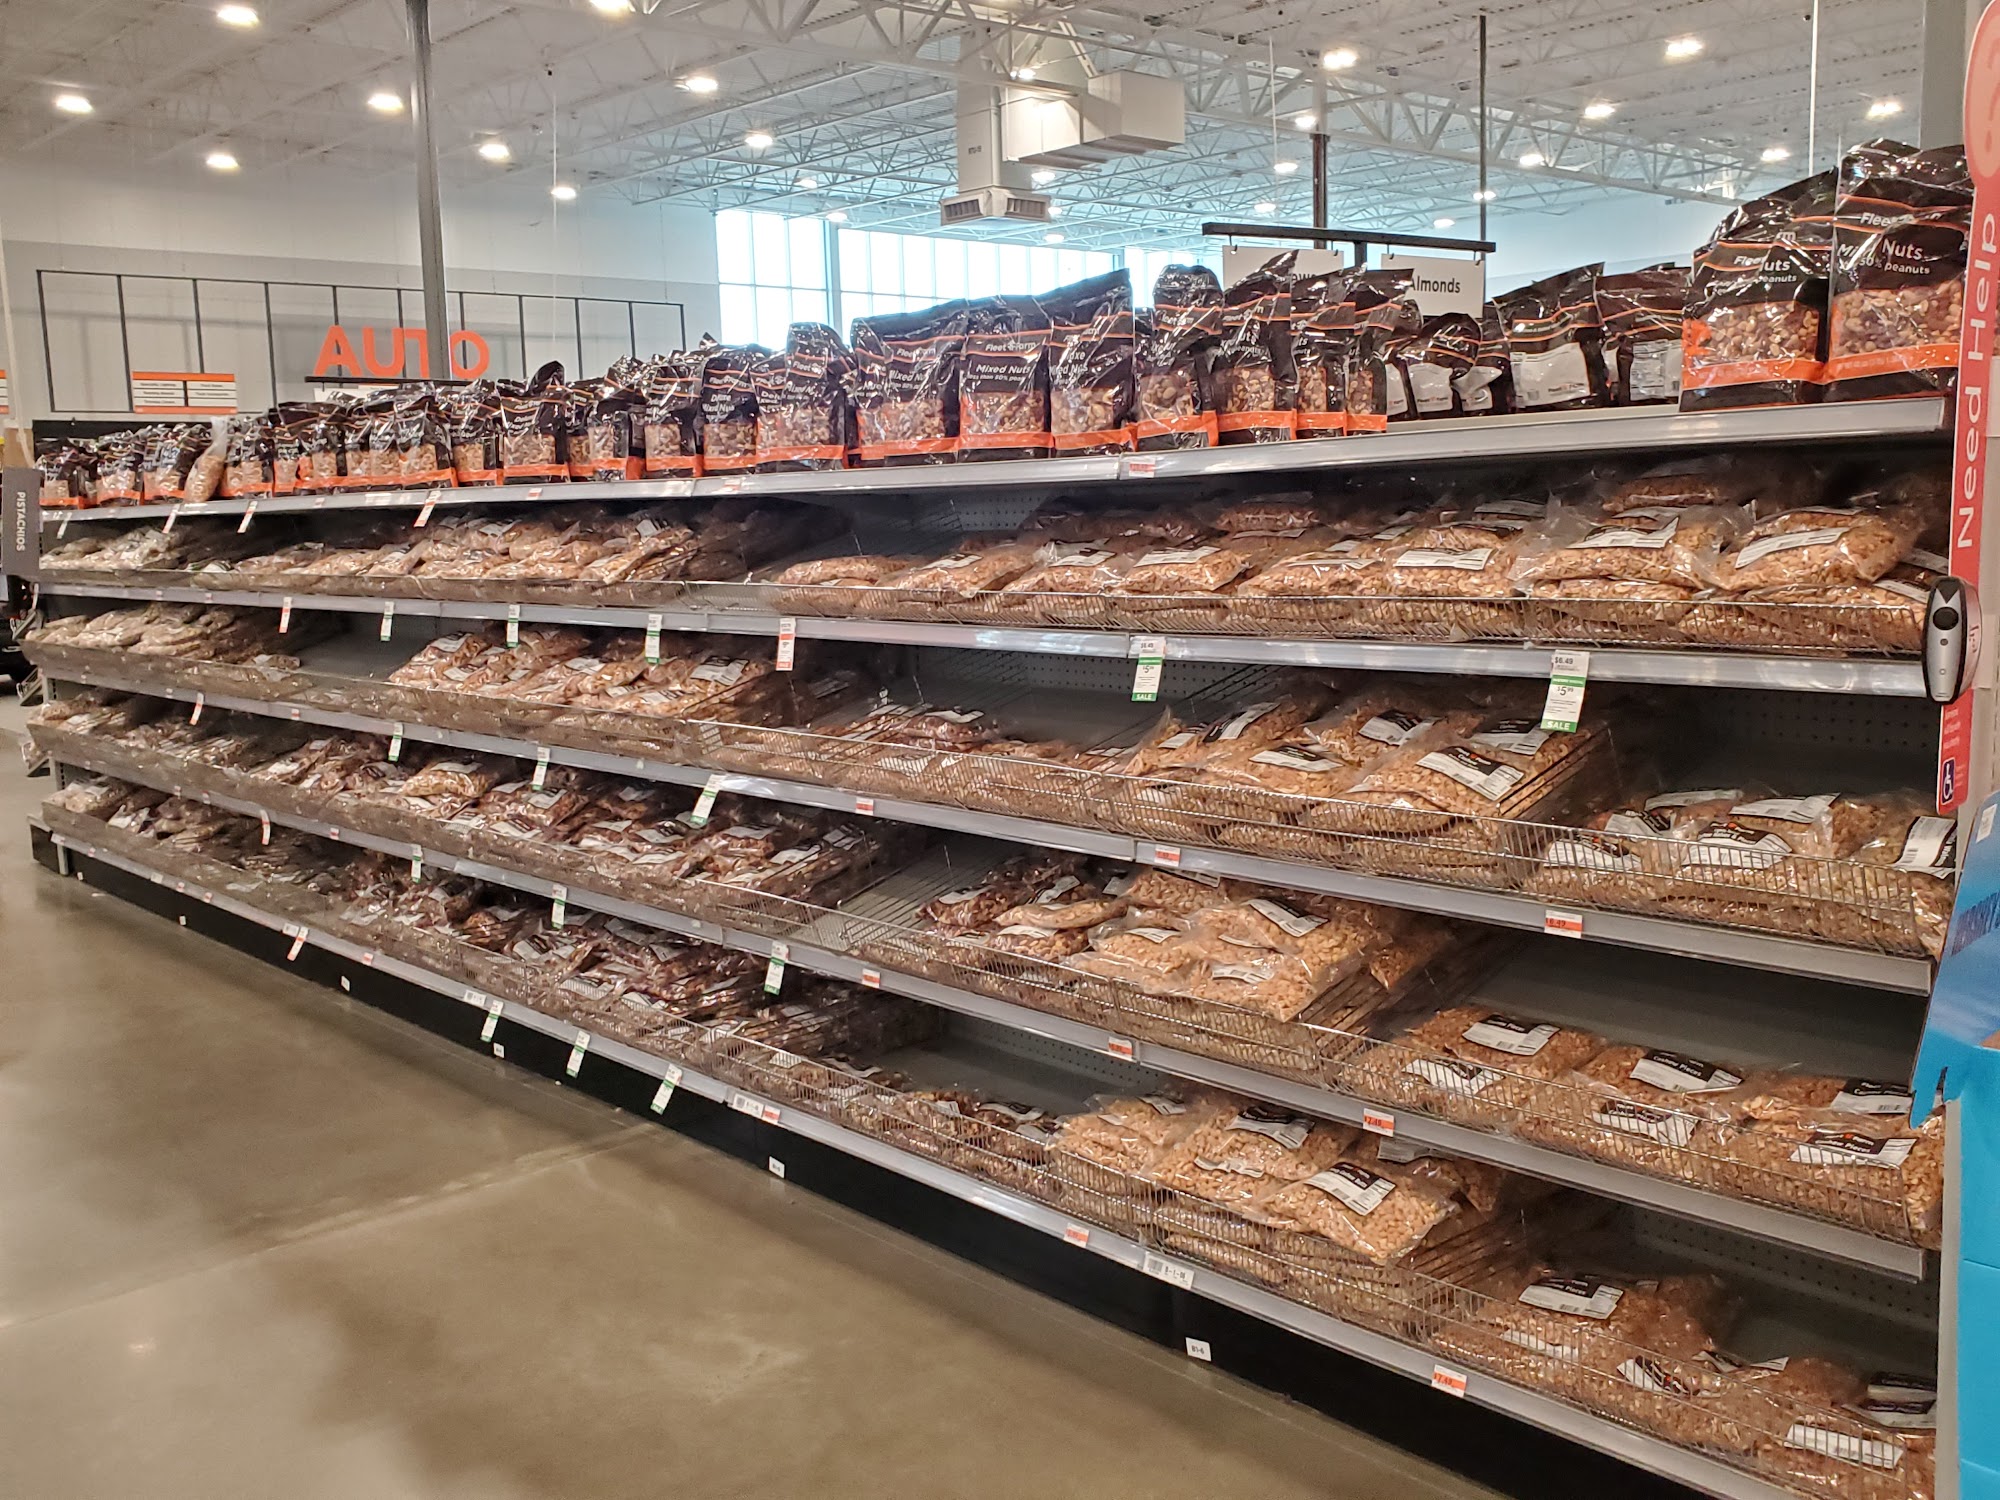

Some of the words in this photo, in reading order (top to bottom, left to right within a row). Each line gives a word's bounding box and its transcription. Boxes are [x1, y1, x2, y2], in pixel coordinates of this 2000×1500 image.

[1882, 238, 1924, 261] Nuts
[1883, 262, 1931, 275] peanuts
[1410, 275, 1461, 294] Almonds
[1968, 213, 1998, 361] Help
[313, 325, 490, 379] AUTO
[985, 343, 1007, 352] Fleet
[975, 364, 1007, 374] Mixed
[1008, 365, 1032, 375] Nuts
[1957, 386, 1983, 548] Need
[15, 491, 27, 552] PISTACHIOS
[1554, 656, 1574, 665] $6.49
[1546, 720, 1571, 730] SALE
